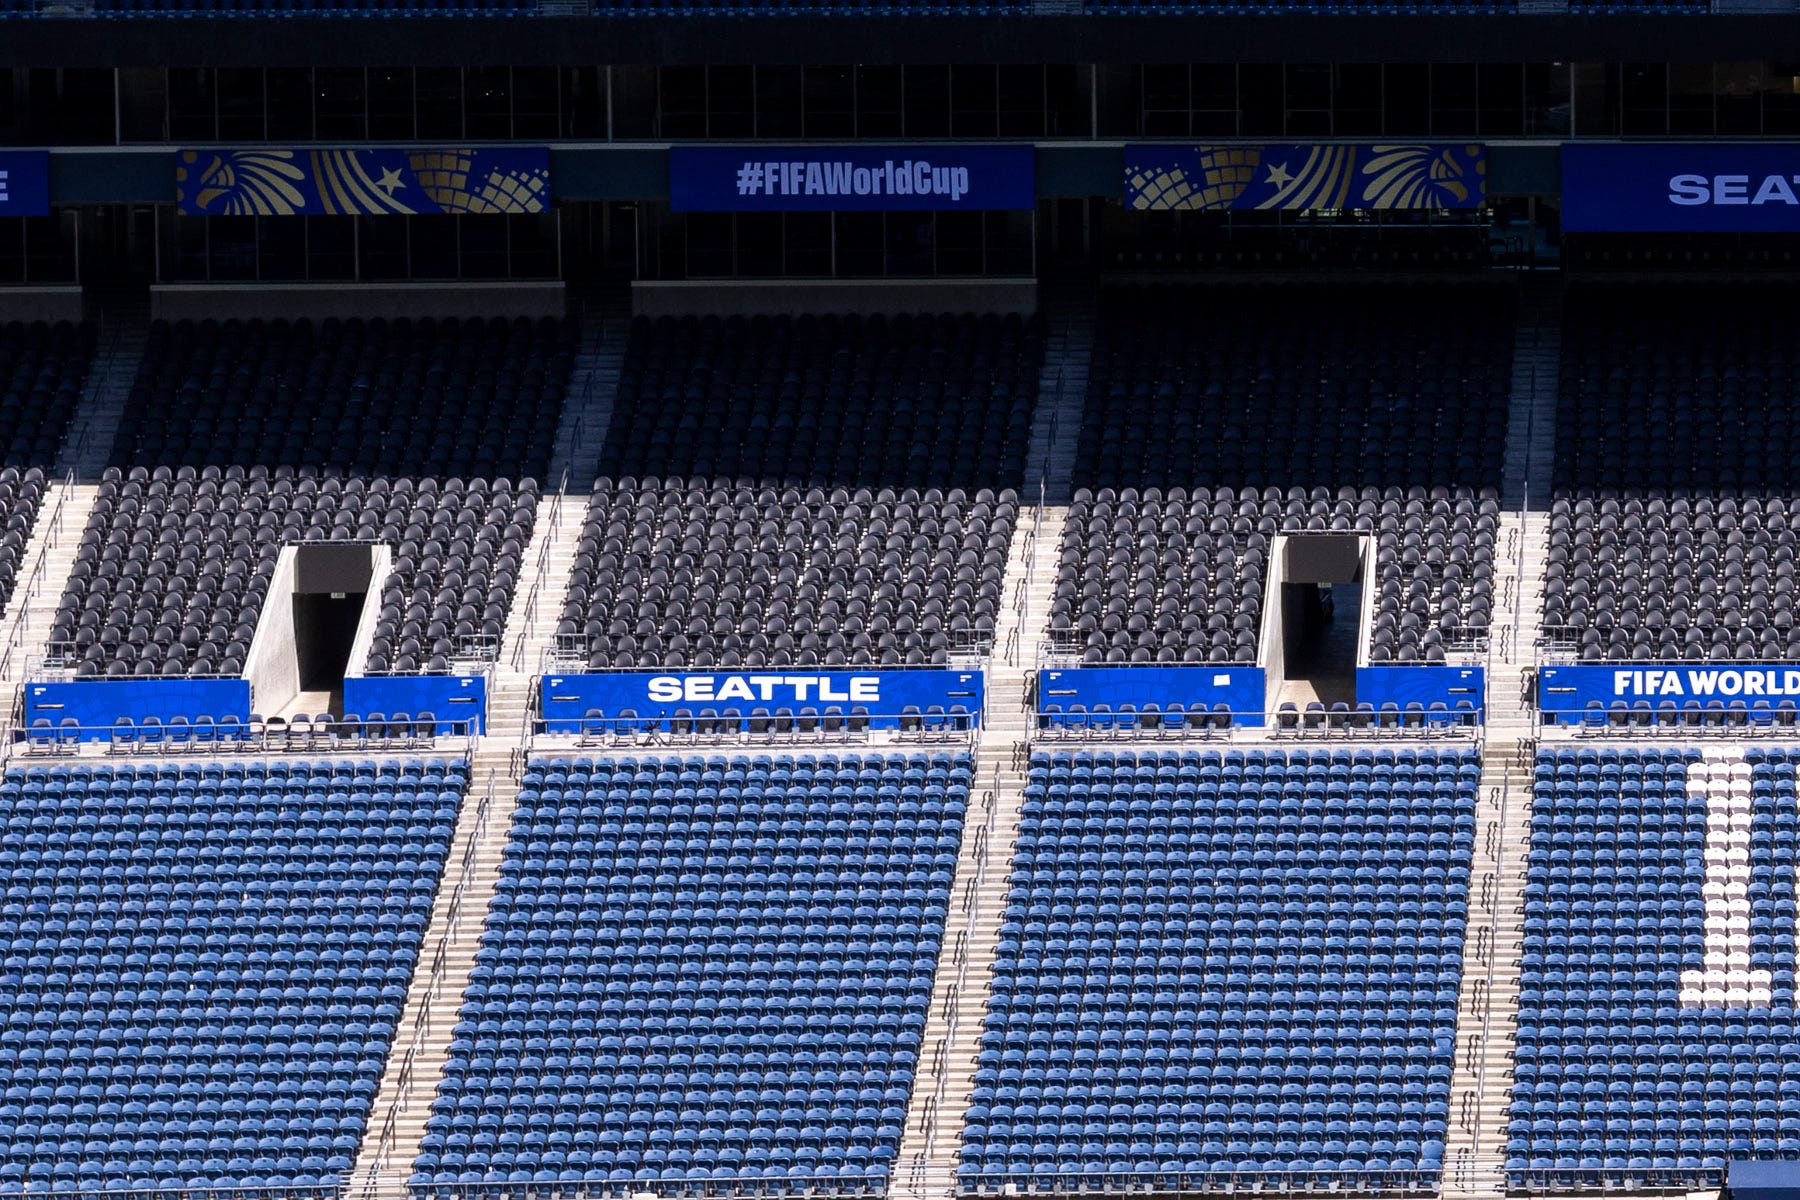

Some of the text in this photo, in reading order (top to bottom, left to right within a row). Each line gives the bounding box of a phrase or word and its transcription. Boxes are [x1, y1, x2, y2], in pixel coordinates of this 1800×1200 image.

[736, 160, 969, 201] #FIFAWorldCup
[648, 676, 880, 702] SEATTLE
[1615, 670, 1684, 696] FIFA
